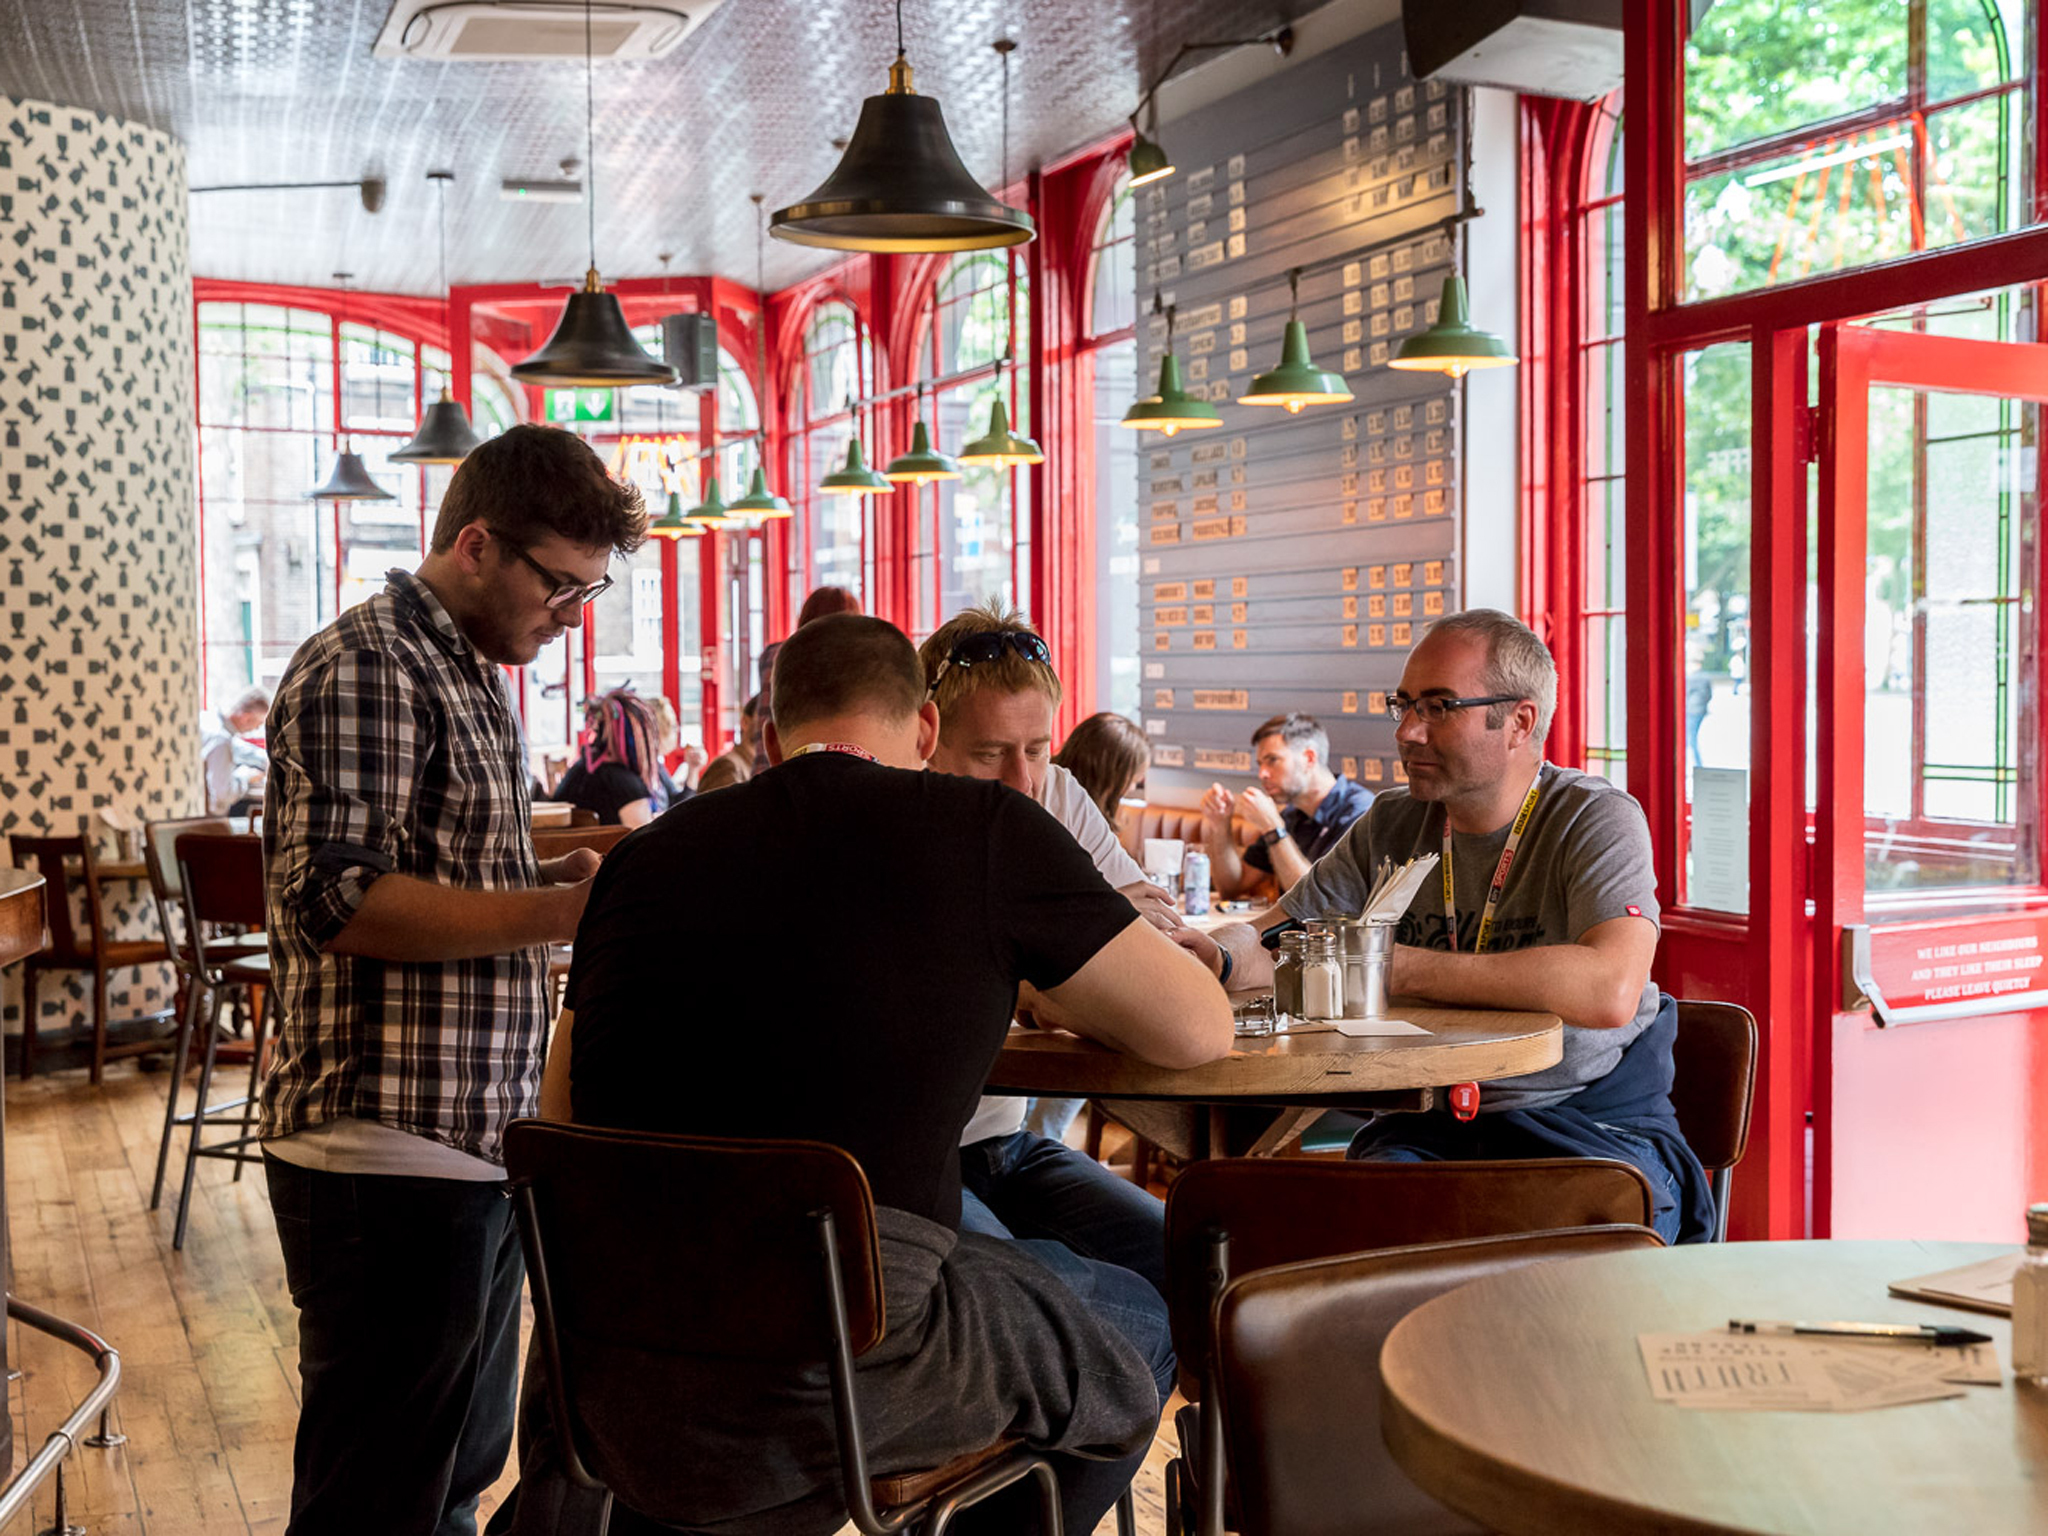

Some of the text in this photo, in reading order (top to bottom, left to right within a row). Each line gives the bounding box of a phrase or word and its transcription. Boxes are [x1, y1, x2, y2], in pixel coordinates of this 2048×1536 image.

[1917, 948, 1933, 959] WE
[1934, 945, 1956, 958] LIKE
[1957, 943, 1978, 955] OUR
[1911, 955, 2043, 981] AND THEY LIKE THEIR SLEEP
[1924, 976, 2031, 1000] PLEASE LEAVE QUIETLY
